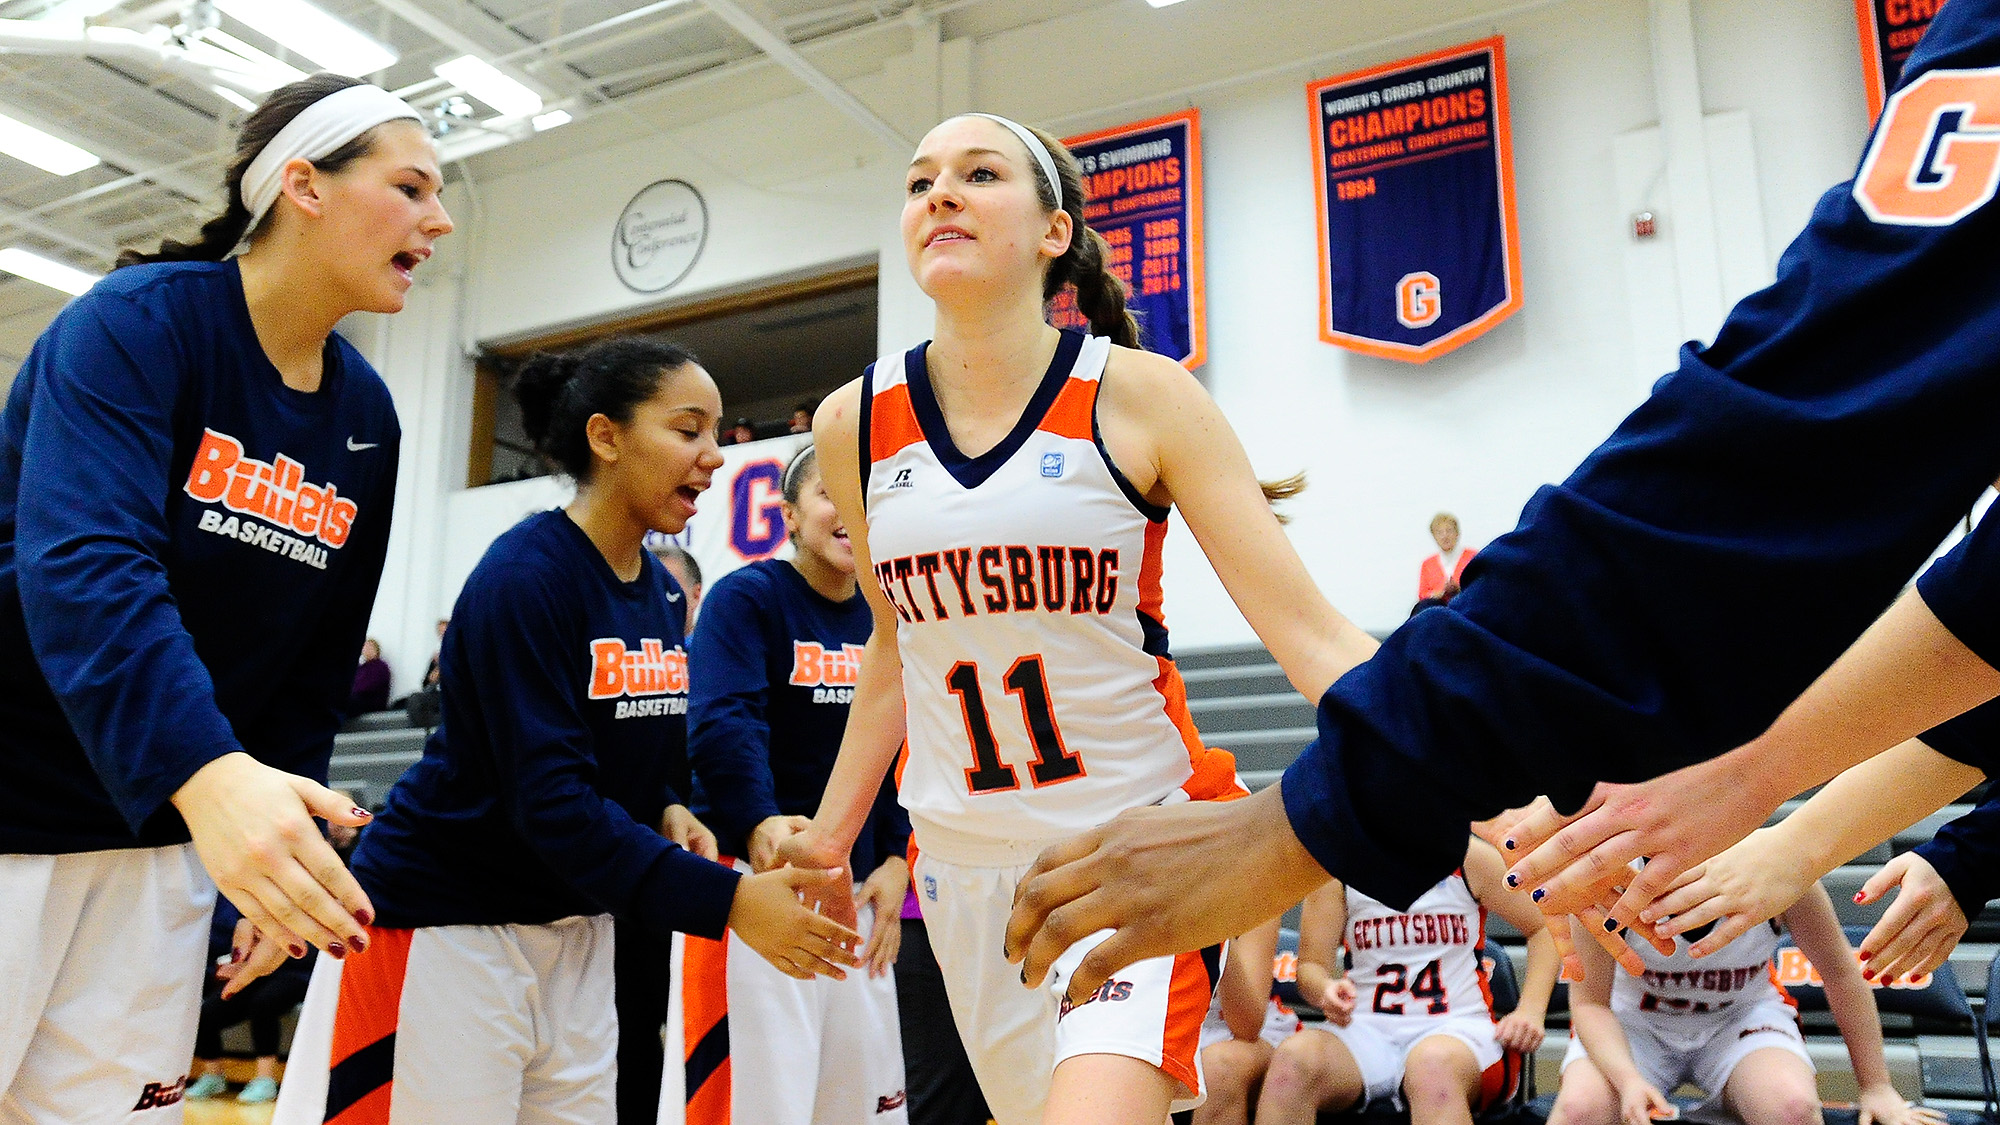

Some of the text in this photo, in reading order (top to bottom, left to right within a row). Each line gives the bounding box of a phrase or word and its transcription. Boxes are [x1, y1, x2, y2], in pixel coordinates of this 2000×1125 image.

[1325, 65, 1486, 116] WOMEN'S CROSS COUNTRY
[1329, 88, 1487, 148] CHAMPIONS
[1098, 138, 1172, 171] SWIMMING
[1330, 120, 1487, 169] CENTENNIAL CONFERENCE
[1852, 66, 2000, 227] G
[1081, 157, 1181, 200] AMPIONS
[1395, 271, 1441, 329] G
[183, 427, 358, 549] Bullets
[198, 509, 327, 570] BASKETBALL
[874, 545, 1120, 624] ETTYSBURG
[789, 639, 865, 687] Bull
[945, 653, 1087, 796] 11
[1373, 958, 1448, 1015] 24
